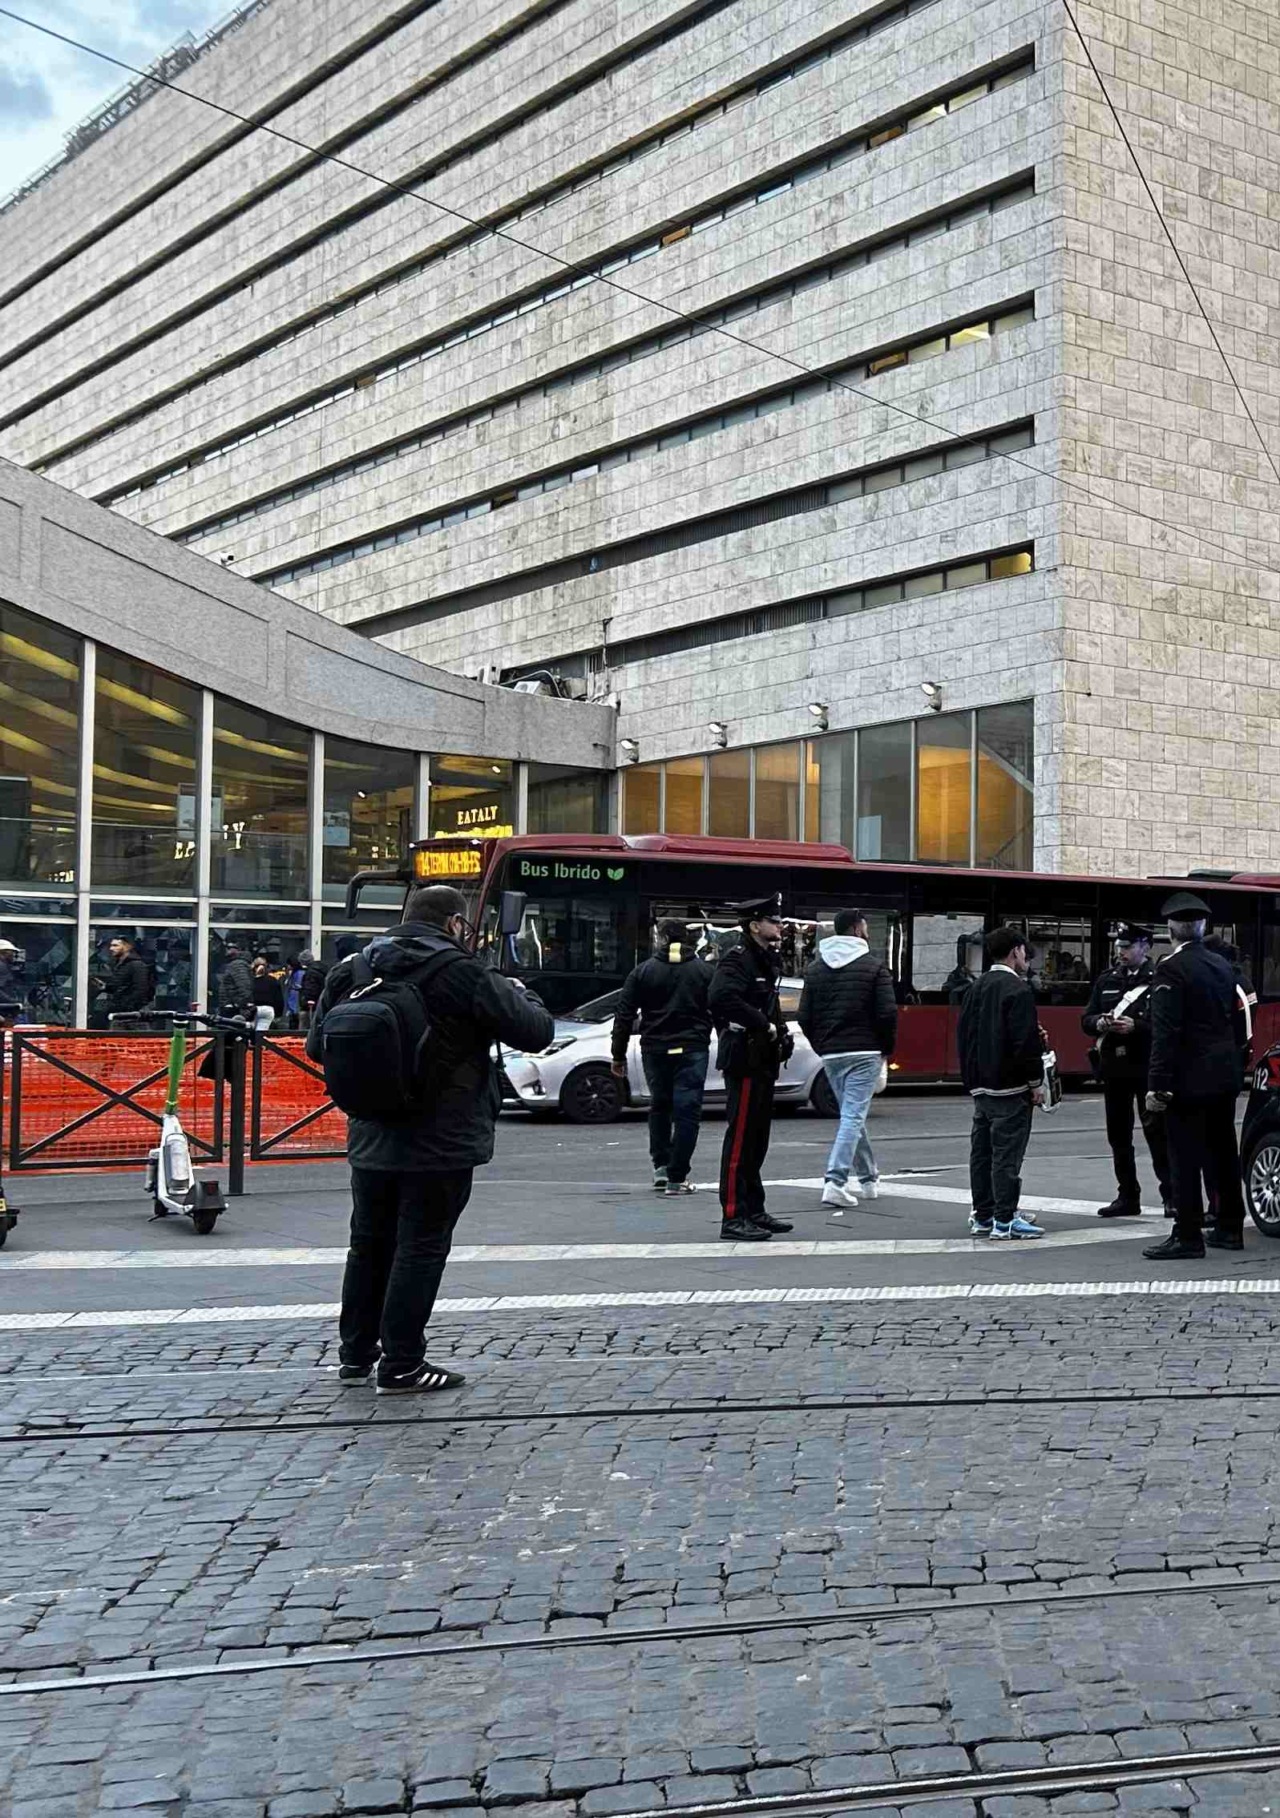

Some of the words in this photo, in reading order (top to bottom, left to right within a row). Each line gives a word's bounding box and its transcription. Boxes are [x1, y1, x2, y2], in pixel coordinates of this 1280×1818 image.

[457, 805, 498, 825] EATALY
[521, 861, 549, 877] Bus
[555, 863, 601, 880] Ibrido
